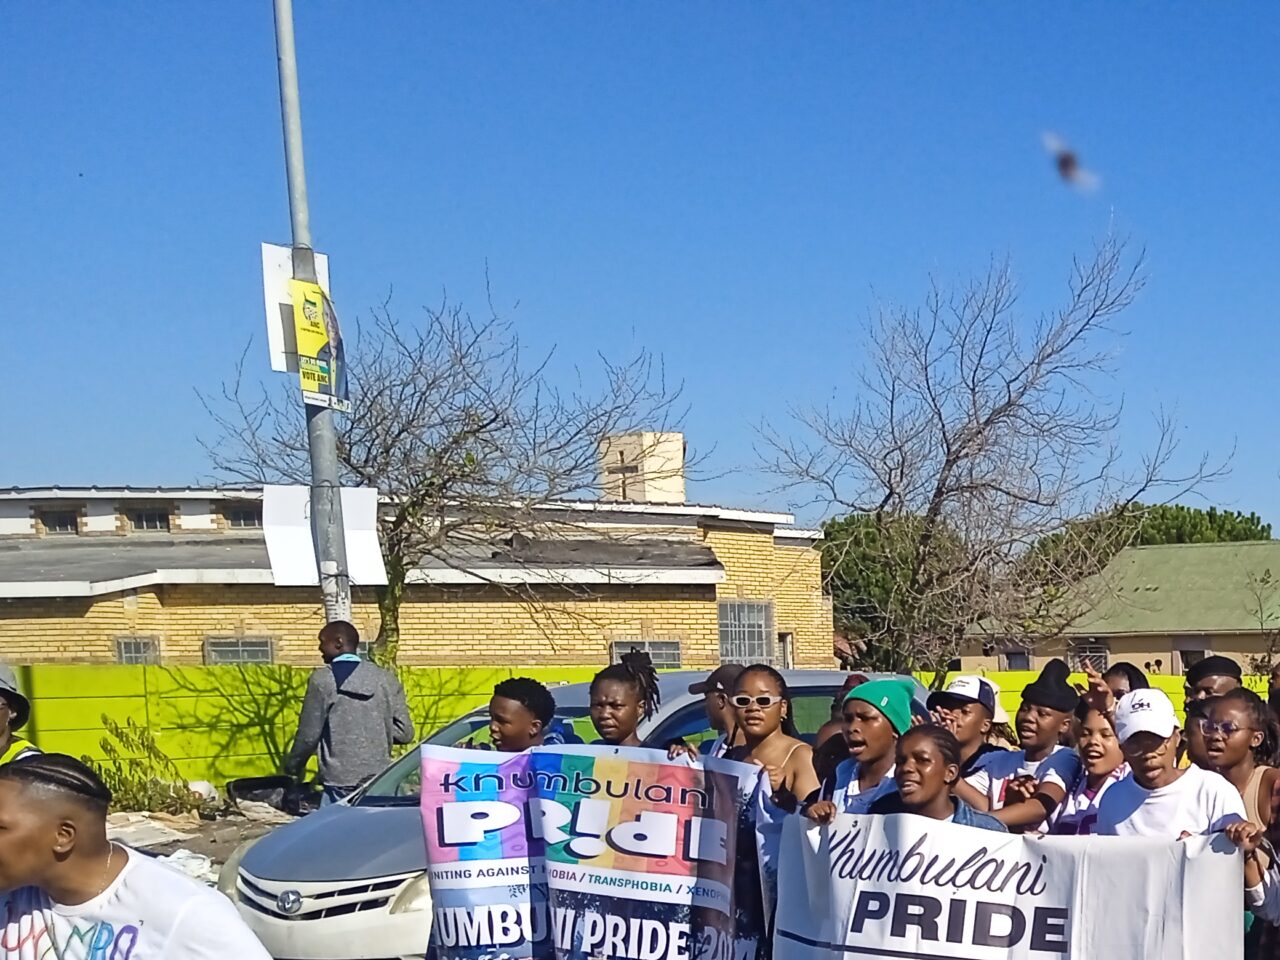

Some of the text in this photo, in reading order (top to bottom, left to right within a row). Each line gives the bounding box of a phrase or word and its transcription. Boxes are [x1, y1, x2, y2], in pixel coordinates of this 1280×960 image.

[302, 370, 328, 383] VOTE ANC
[477, 865, 536, 878] AGAINST
[588, 873, 673, 893] TRANSPHOBIA
[850, 891, 1069, 954] PRIDE
